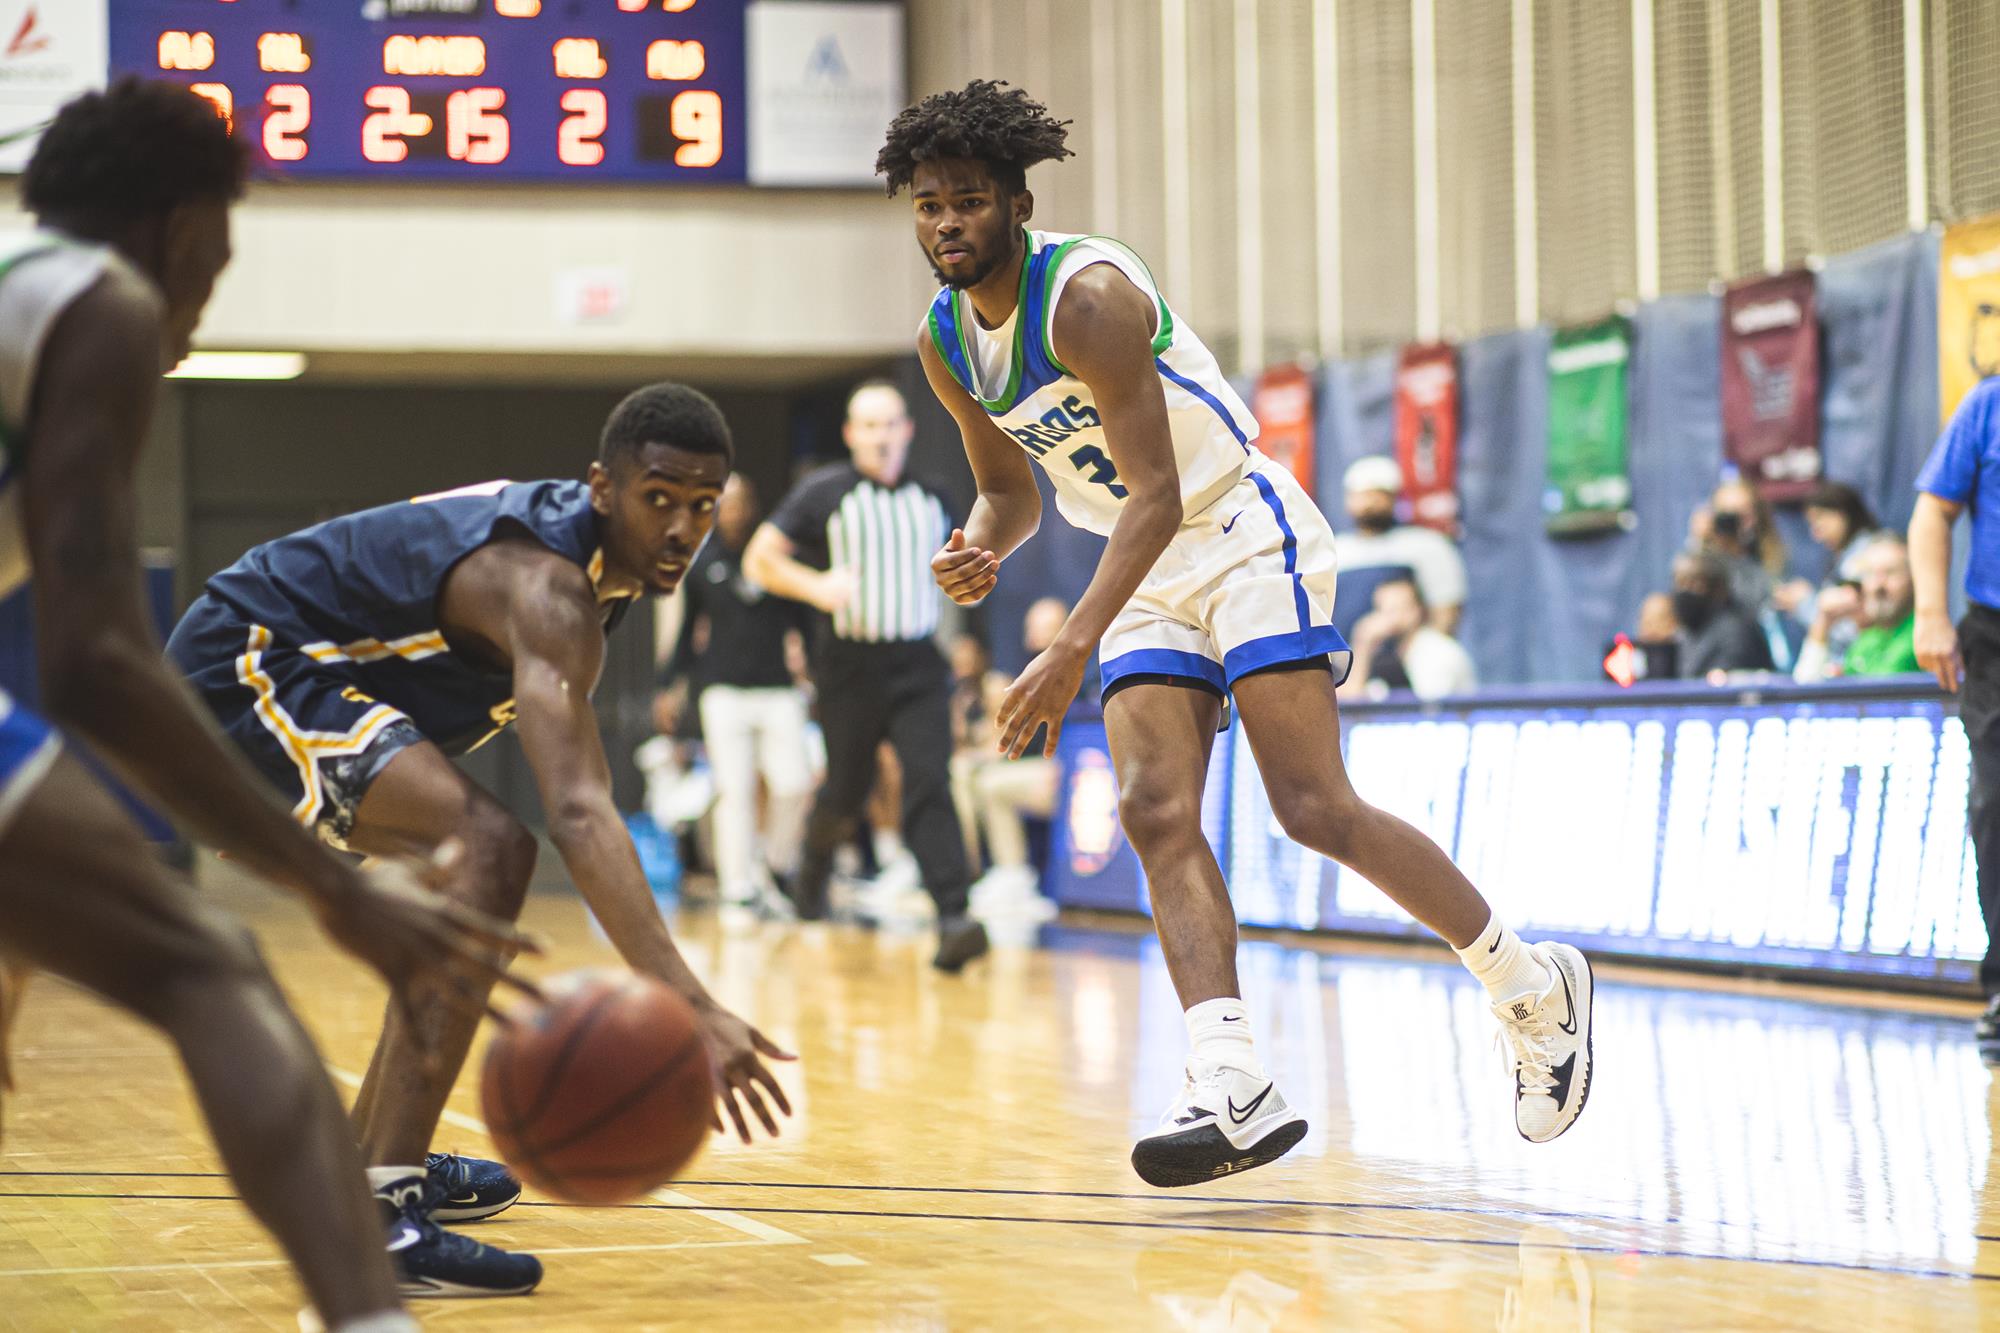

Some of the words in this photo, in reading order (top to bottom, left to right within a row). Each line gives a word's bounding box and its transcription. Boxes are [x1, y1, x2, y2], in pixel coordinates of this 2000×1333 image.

[263, 84, 310, 160] 2
[558, 89, 607, 165] 2
[671, 90, 722, 167] 9
[1003, 395, 1101, 460] RGOS
